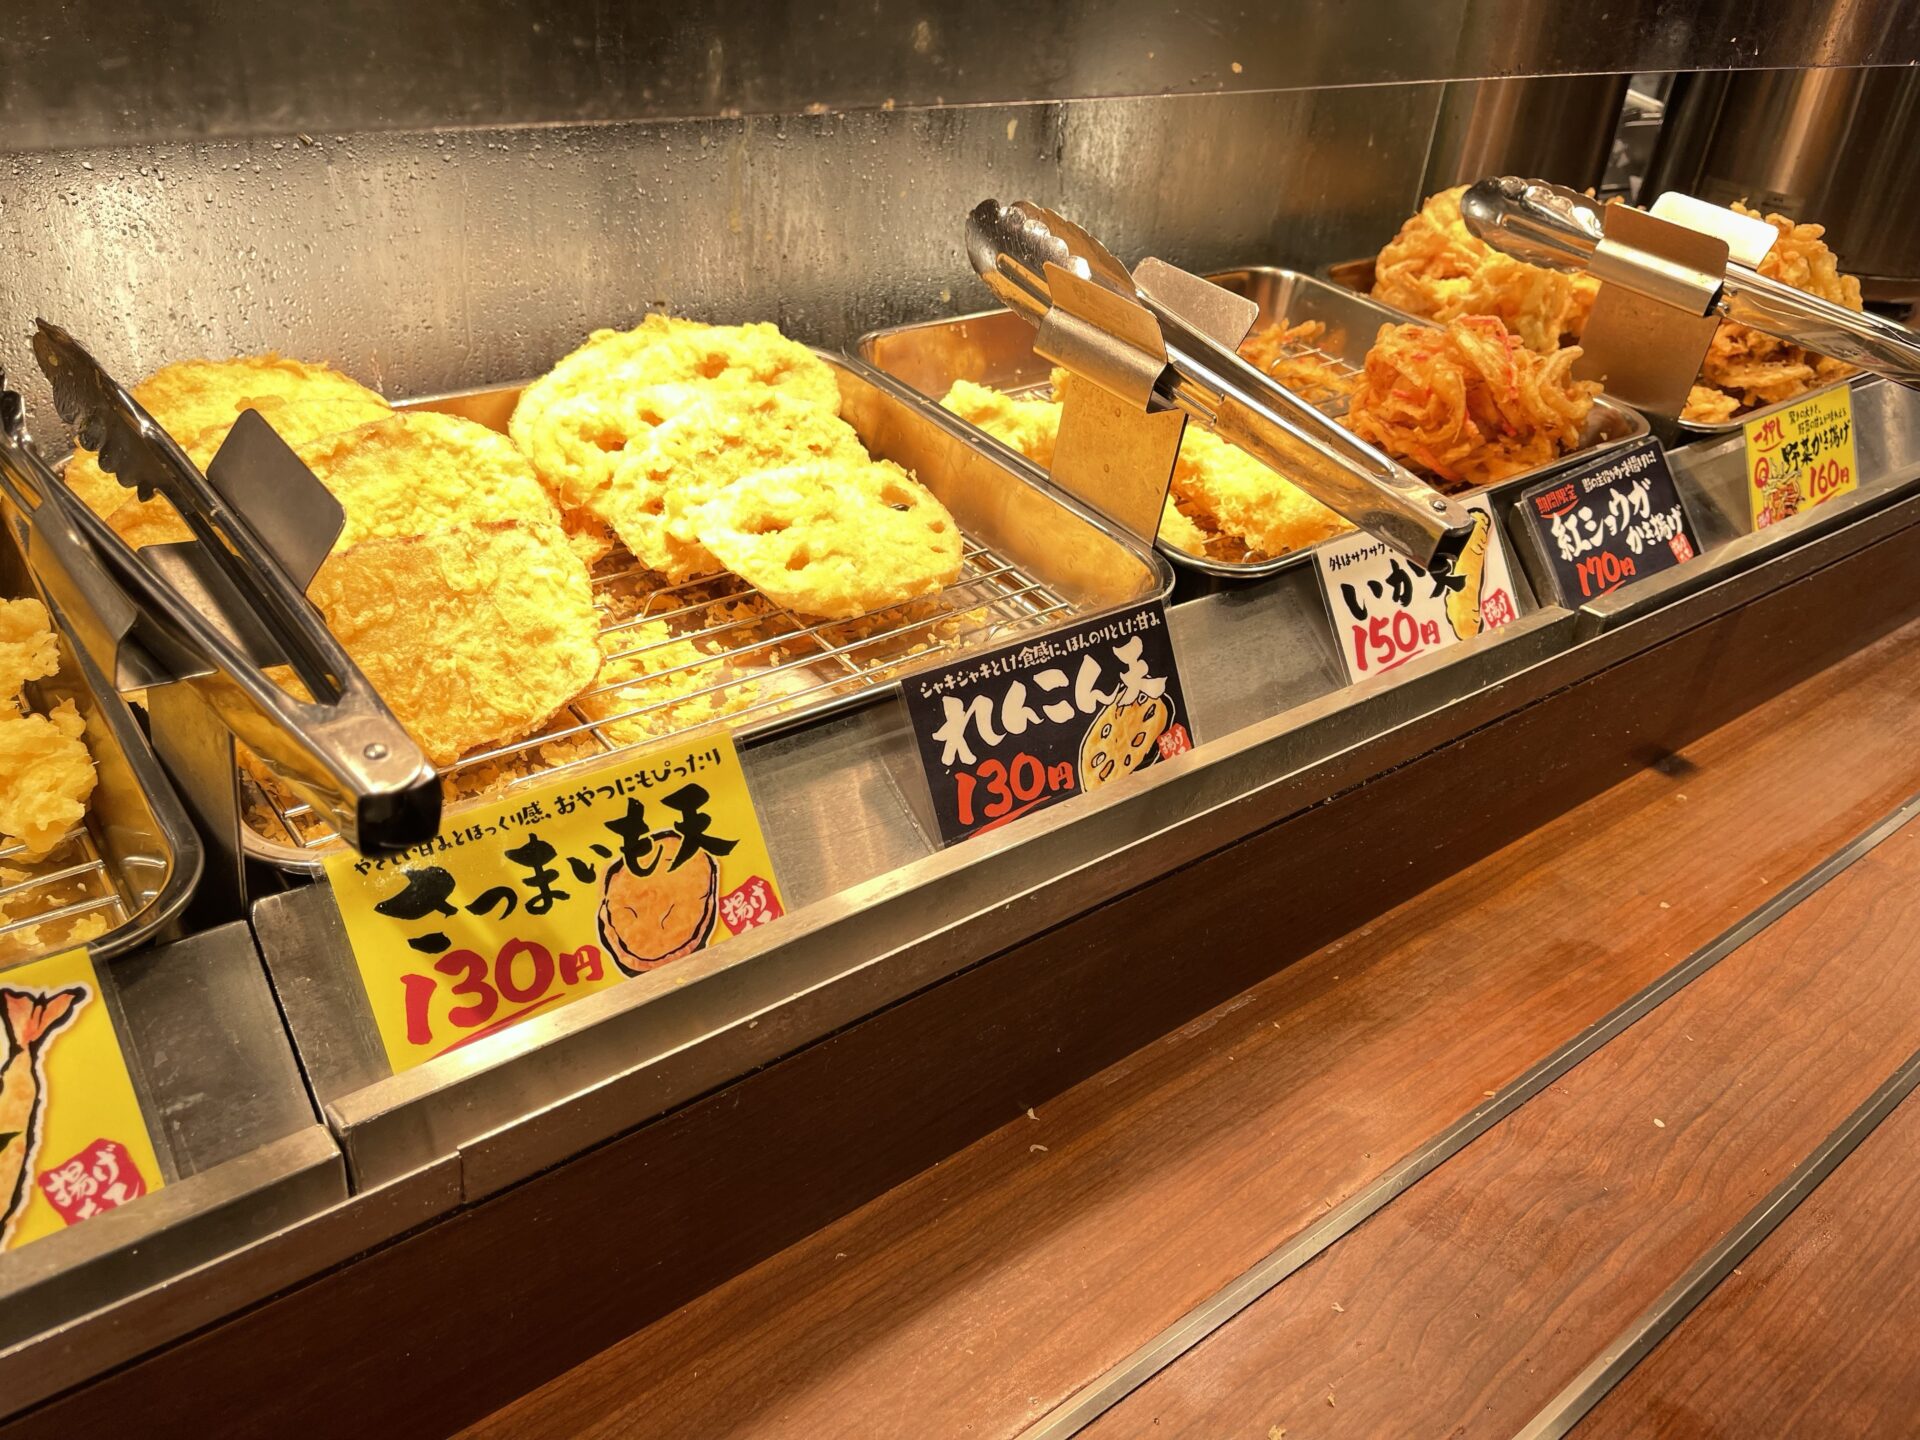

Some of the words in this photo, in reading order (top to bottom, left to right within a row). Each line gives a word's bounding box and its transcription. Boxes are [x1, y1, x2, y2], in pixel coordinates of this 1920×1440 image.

[1781, 419, 1850, 474] 野菜かき揚げ
[1536, 484, 1577, 513] 期間限定
[1809, 459, 1849, 497] 160円
[1551, 478, 1651, 562] 紅ショウガ
[1626, 504, 1681, 554] かき揚げ
[1576, 551, 1636, 596] 170円
[1352, 610, 1440, 671] 150円
[932, 636, 1168, 766] れんこん天
[955, 752, 1075, 825] 130円
[374, 782, 739, 954] さつまいも天
[721, 880, 767, 926] 揚げ
[400, 938, 604, 1044] 130円
[45, 1144, 119, 1207] 揚げ
